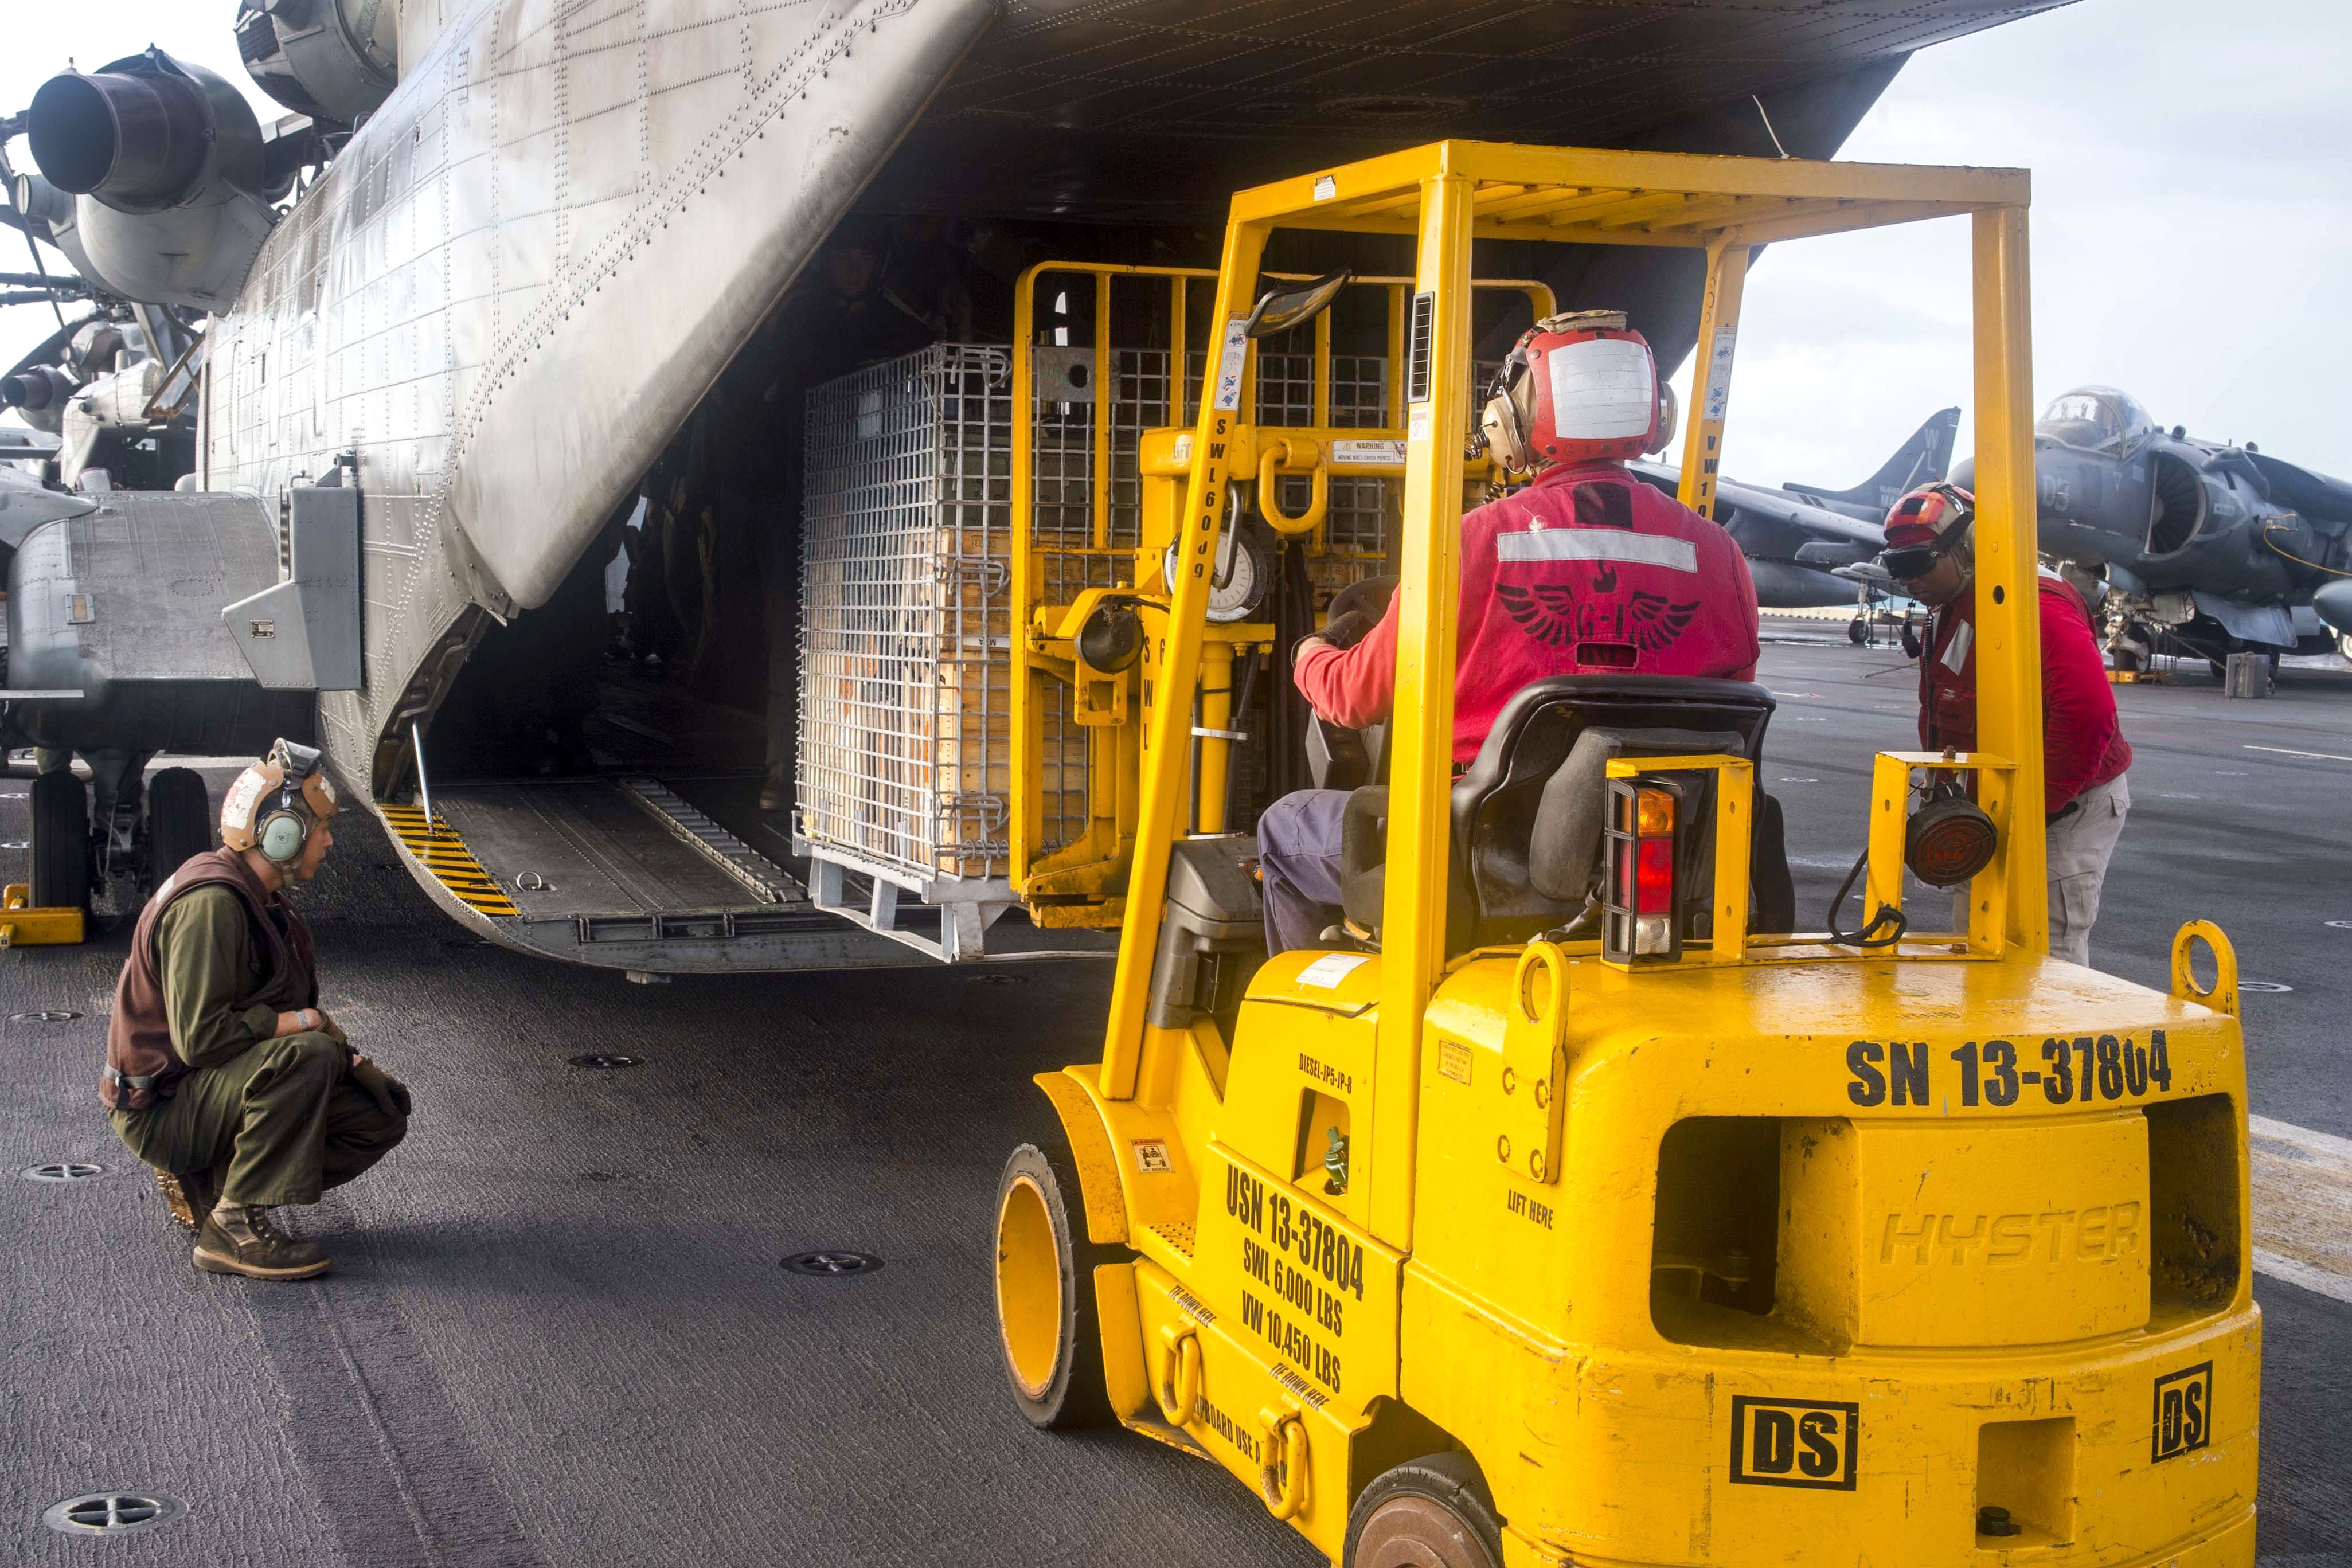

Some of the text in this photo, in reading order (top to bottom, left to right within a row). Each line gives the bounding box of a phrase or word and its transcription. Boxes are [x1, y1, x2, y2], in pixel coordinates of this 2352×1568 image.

[1299, 1053, 1353, 1094] DIESEL-JP5-JP-8
[1846, 1030, 2172, 1107] SN 13-37804
[1226, 1163, 1364, 1302] USN 13-37804
[1507, 1189, 1554, 1230] LIFT HERE
[1879, 1201, 2142, 1266] HYSTER
[1168, 1285, 1217, 1329] TIE DOWN HERE
[1244, 1237, 1343, 1339] SWL 6,000 LBS
[1242, 1289, 1341, 1394] VW 10,450 LBS
[1269, 1362, 1330, 1411] TIE DOWN HERE
[2161, 1379, 2203, 1454] DS
[1236, 1424, 1253, 1460] USE
[1752, 1408, 1839, 1479] DS
